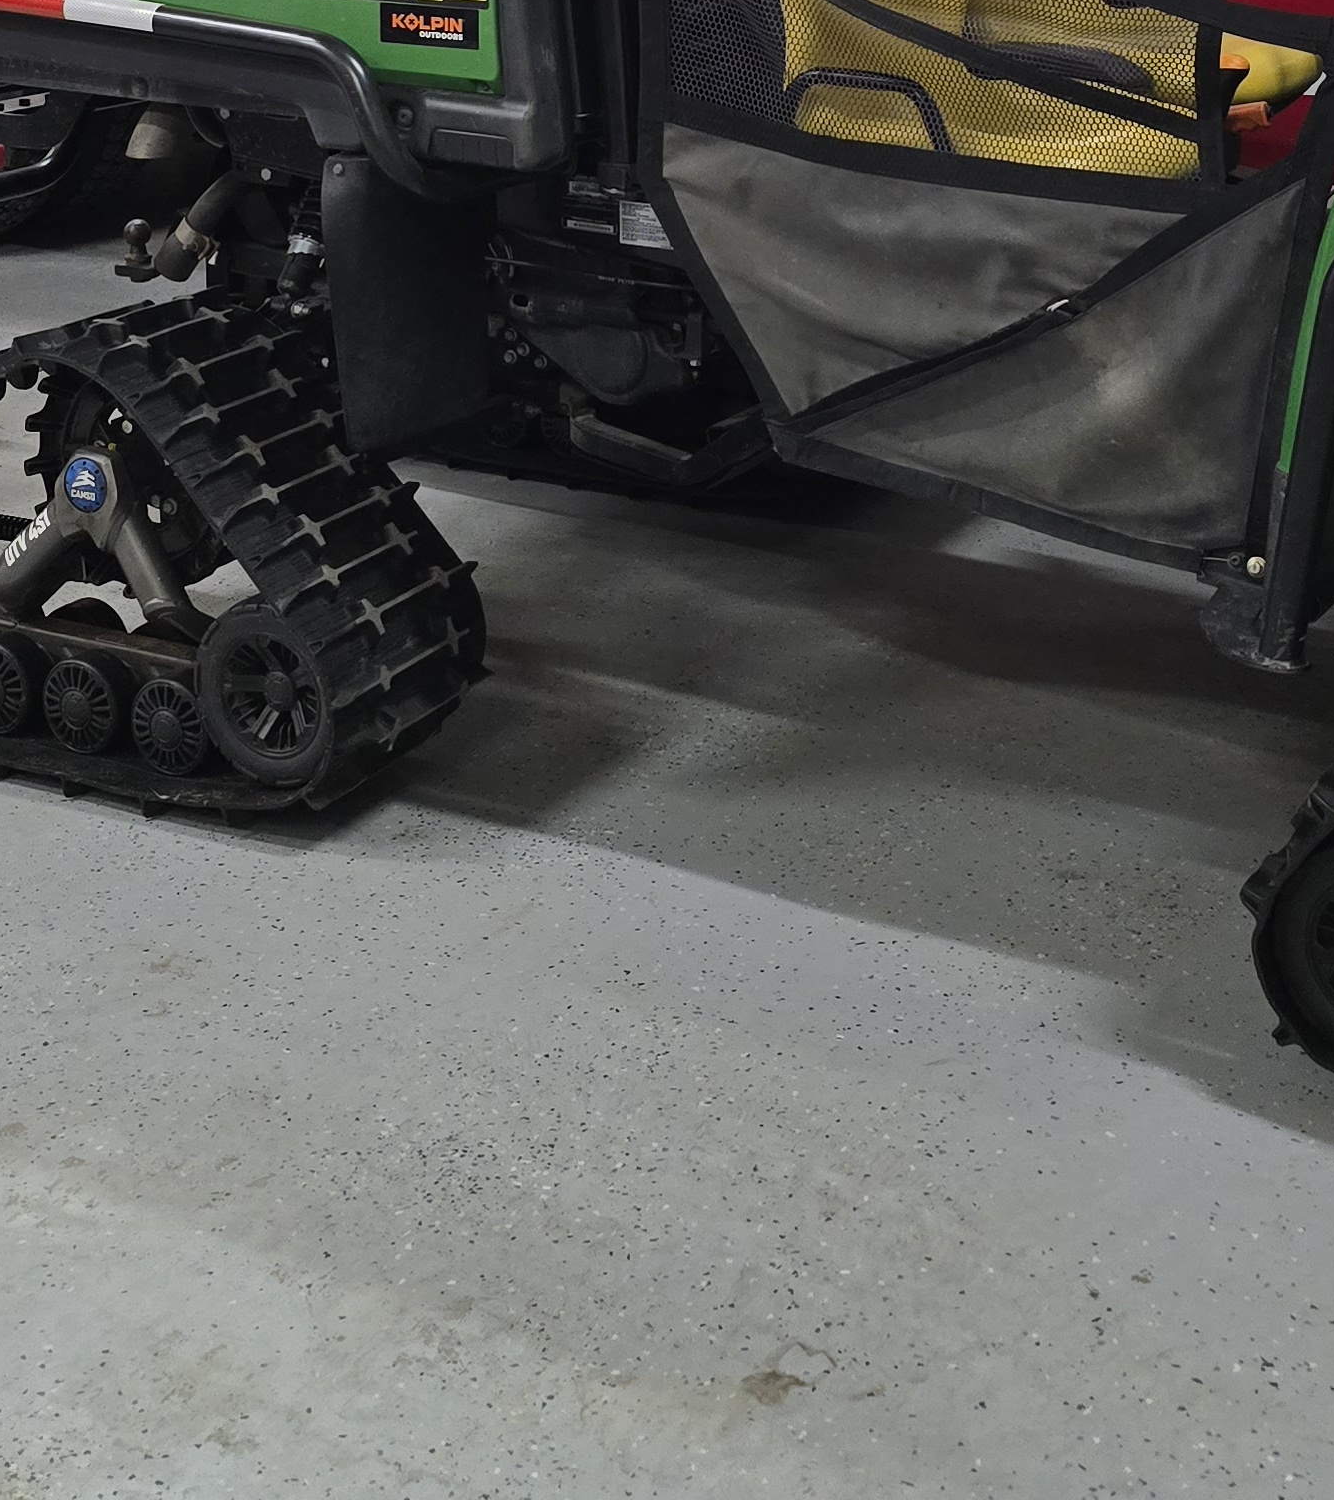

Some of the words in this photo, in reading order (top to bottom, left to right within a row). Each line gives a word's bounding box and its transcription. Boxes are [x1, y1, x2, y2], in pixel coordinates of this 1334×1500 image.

[391, 12, 464, 33] KOLPIN
[419, 30, 464, 41] OUTDOORS
[70, 488, 96, 502] CAMSO
[4, 527, 28, 567] UTV
[28, 506, 51, 541] 4S1
